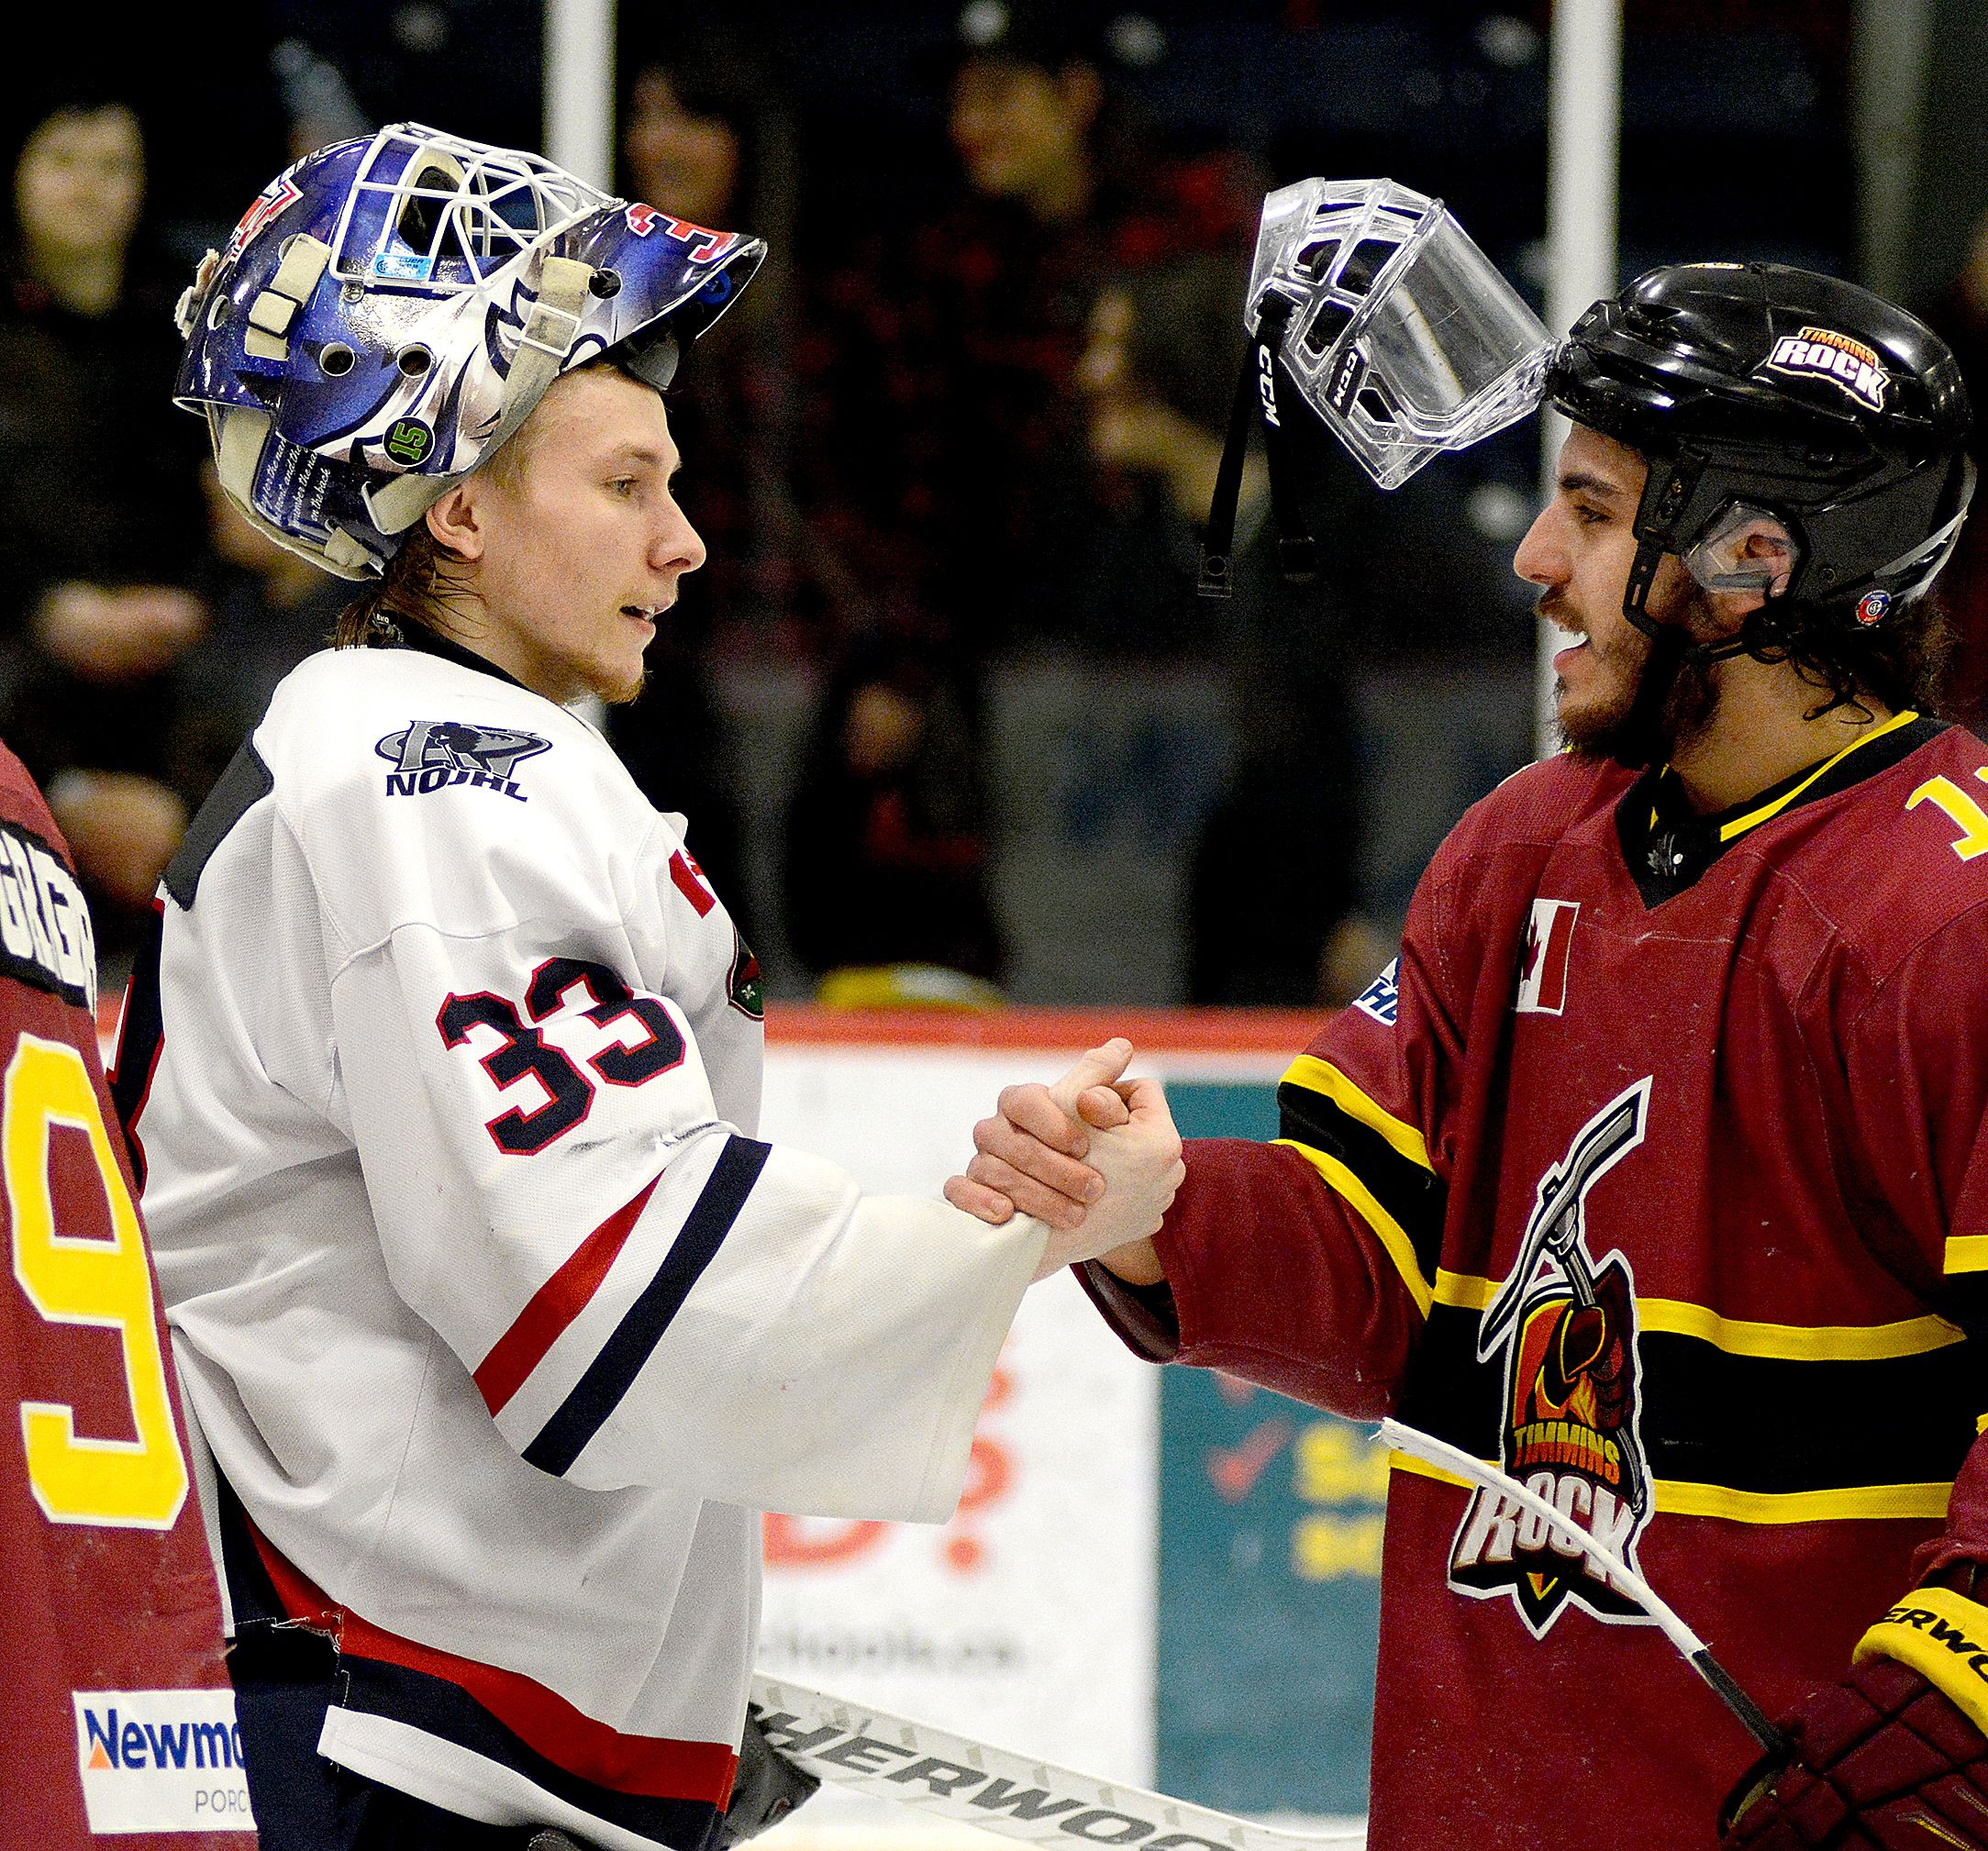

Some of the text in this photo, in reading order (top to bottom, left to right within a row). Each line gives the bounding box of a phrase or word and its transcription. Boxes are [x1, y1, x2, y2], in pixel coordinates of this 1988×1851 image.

[1771, 339, 1883, 404] ROCK
[1802, 329, 1874, 366] TIMMINS
[1260, 344, 1281, 427] CCM
[1333, 351, 1359, 407] CCM
[389, 422, 428, 460] 15
[284, 459, 297, 486] and
[298, 468, 312, 487] the
[311, 493, 324, 510] the
[314, 467, 331, 494] back
[385, 768, 528, 803] NOJHL
[1905, 766, 1988, 862] 1
[436, 957, 687, 1157] 33
[3, 1032, 189, 1532] 9
[1513, 1421, 1621, 1485] TIMMINS
[1452, 1471, 1637, 1602] ROCK
[755, 1712, 1235, 1851] HERWO
